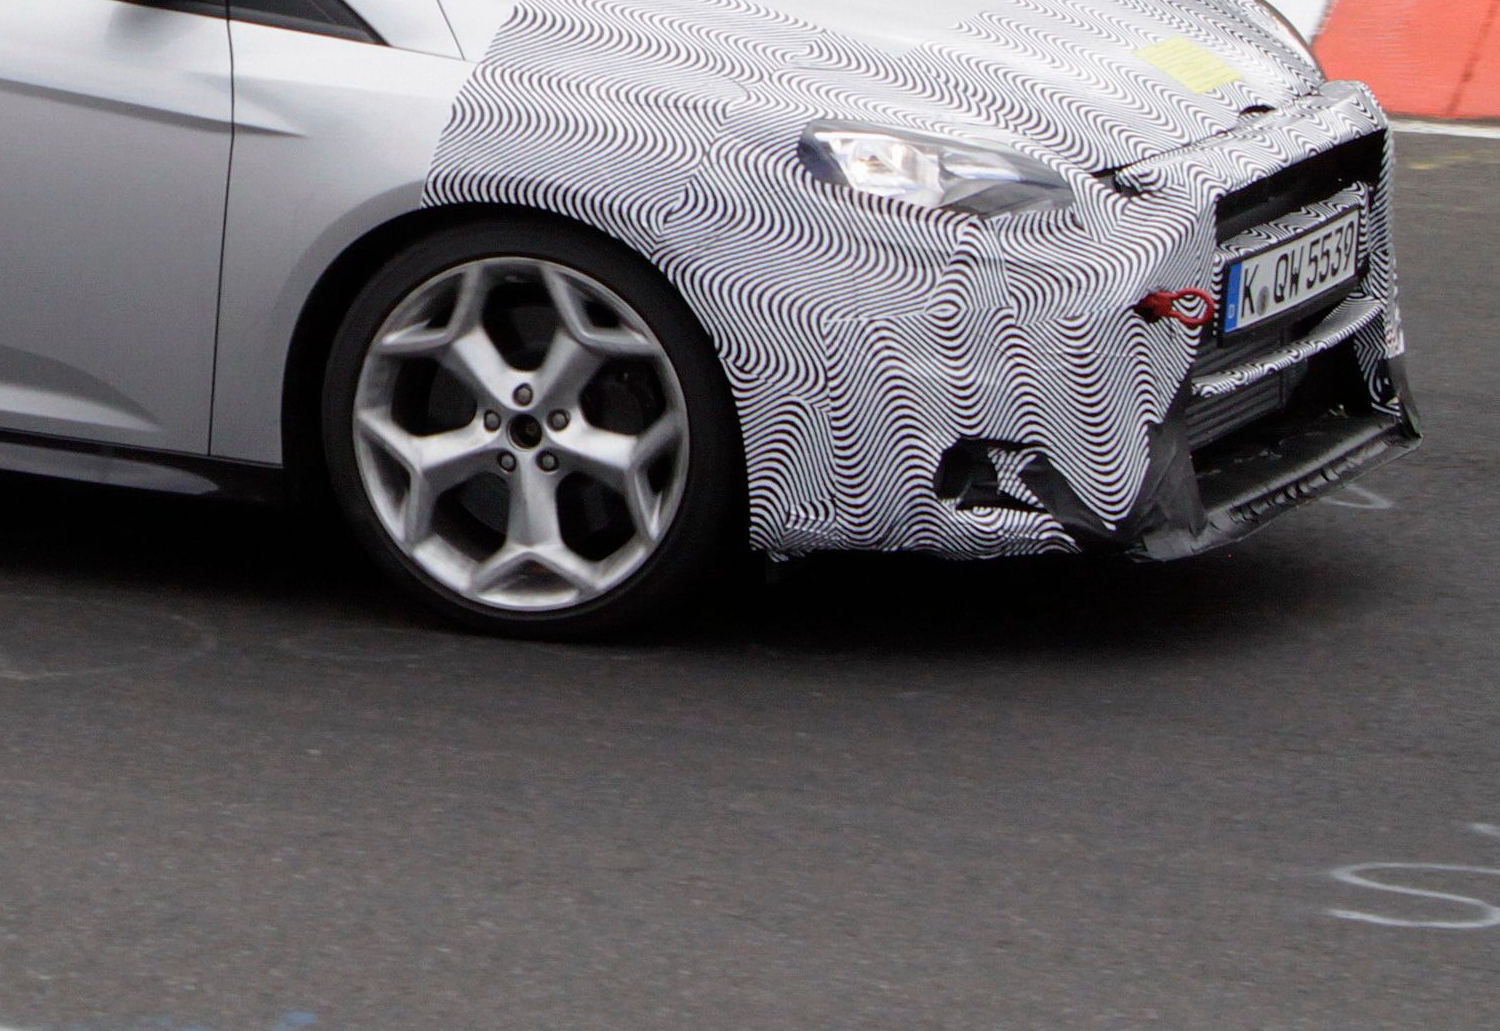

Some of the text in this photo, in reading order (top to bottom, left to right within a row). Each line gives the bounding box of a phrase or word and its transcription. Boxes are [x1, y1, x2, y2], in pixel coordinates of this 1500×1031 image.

[1241, 220, 1355, 318] K QW 5539
